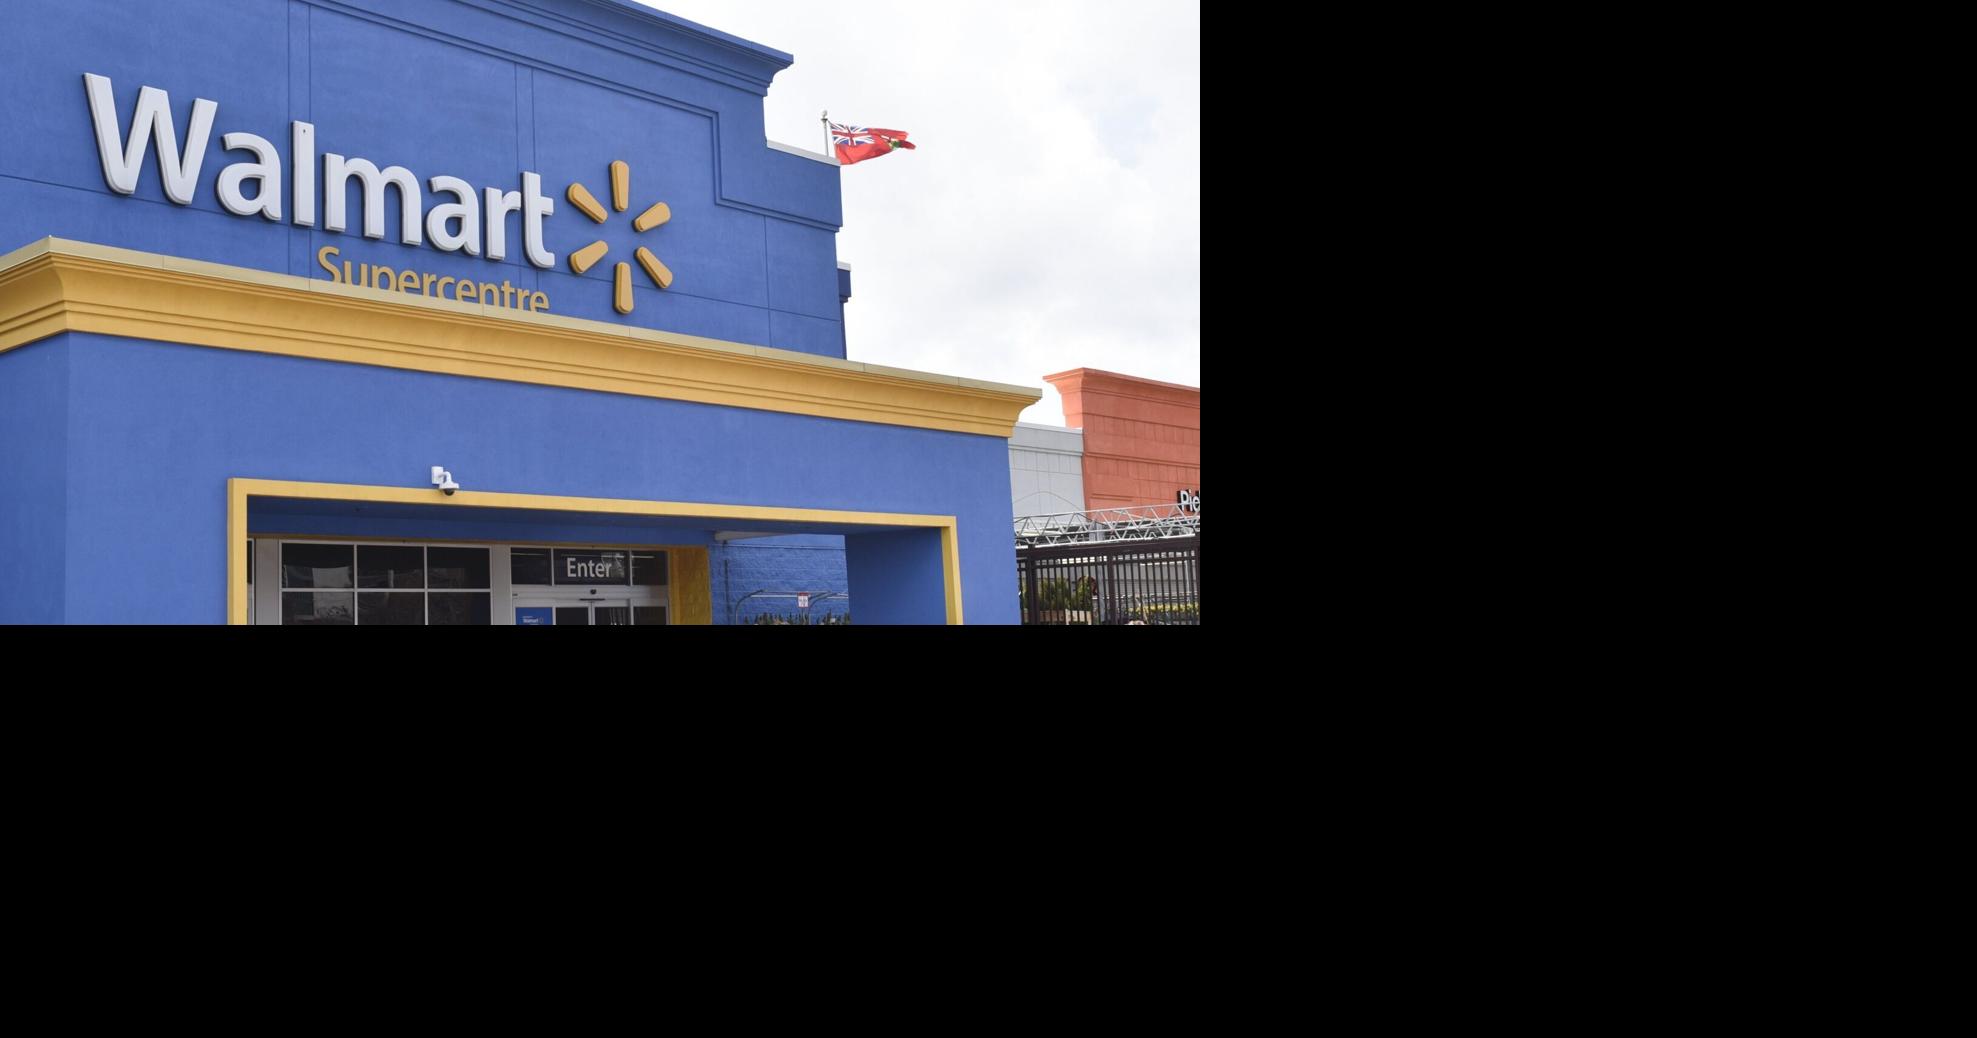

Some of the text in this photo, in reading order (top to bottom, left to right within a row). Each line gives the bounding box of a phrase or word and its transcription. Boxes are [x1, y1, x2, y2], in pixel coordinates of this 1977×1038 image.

[84, 72, 555, 269] Walmart
[317, 246, 550, 312] Supercentre
[566, 557, 612, 578] Enter
